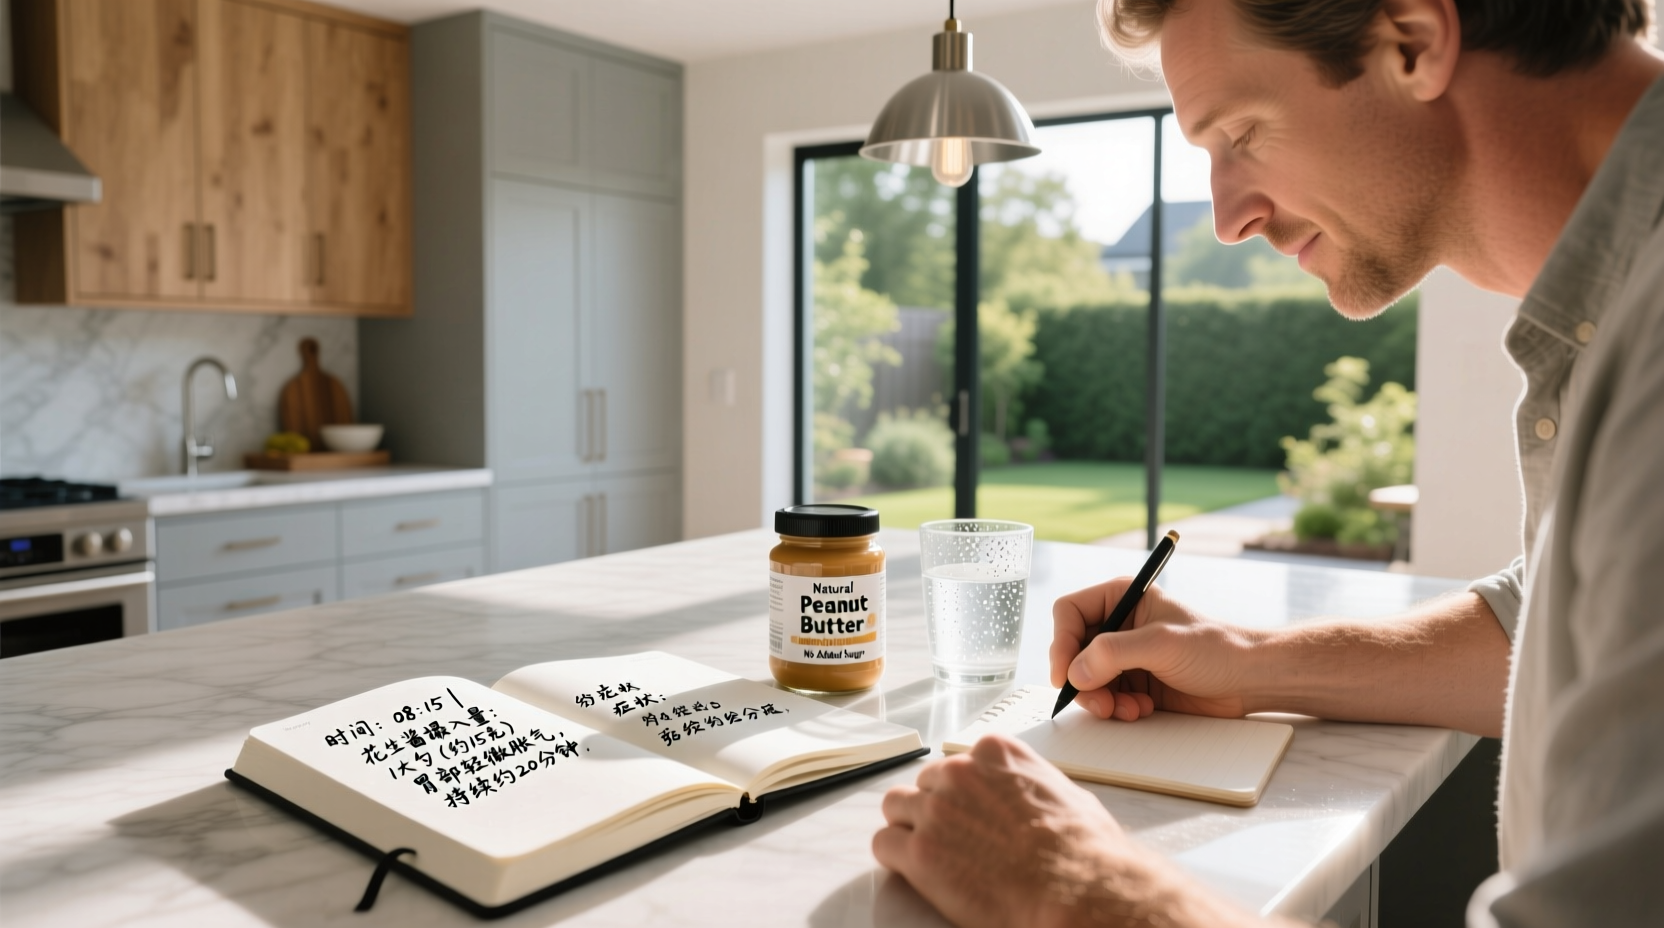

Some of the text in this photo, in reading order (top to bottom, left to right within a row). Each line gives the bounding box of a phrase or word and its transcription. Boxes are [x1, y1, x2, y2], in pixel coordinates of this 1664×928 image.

[813, 580, 854, 594] Natural
[800, 595, 869, 614] Peanut
[800, 615, 865, 635] Butter
[393, 696, 443, 724] 08:15
